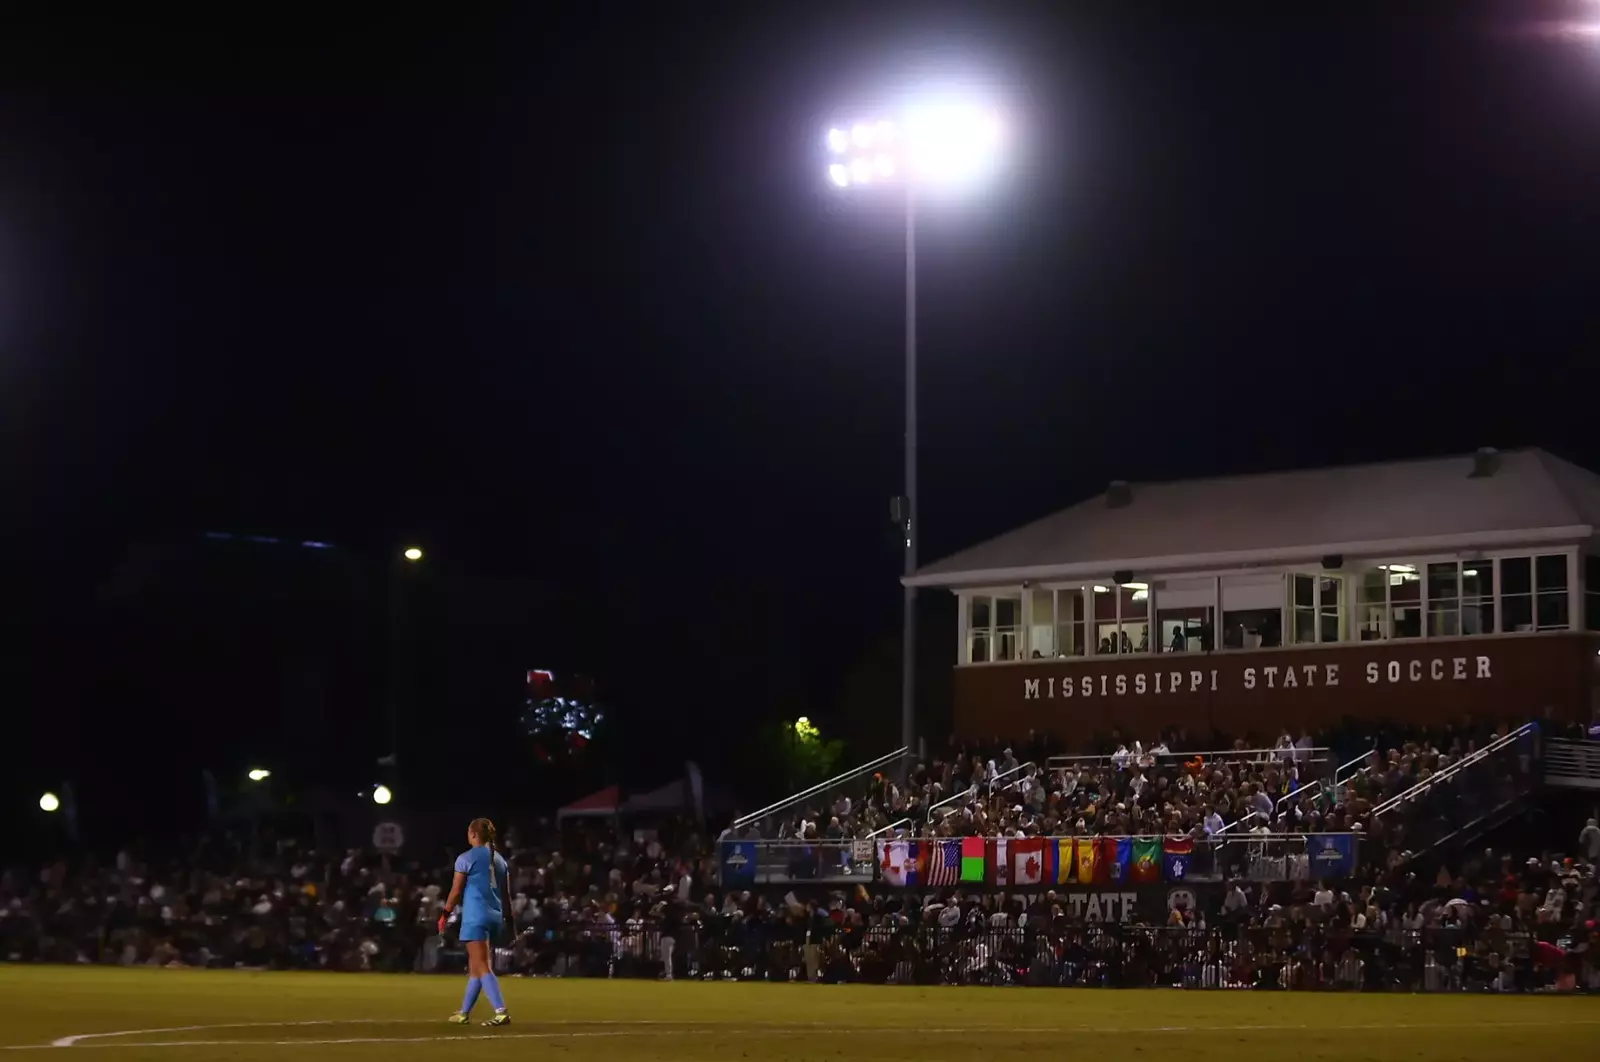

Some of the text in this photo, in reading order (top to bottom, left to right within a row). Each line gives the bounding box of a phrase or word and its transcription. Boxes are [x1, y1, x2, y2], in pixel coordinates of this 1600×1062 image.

[1024, 655, 1492, 699] MISSISSIPPI STATE SOCCER
